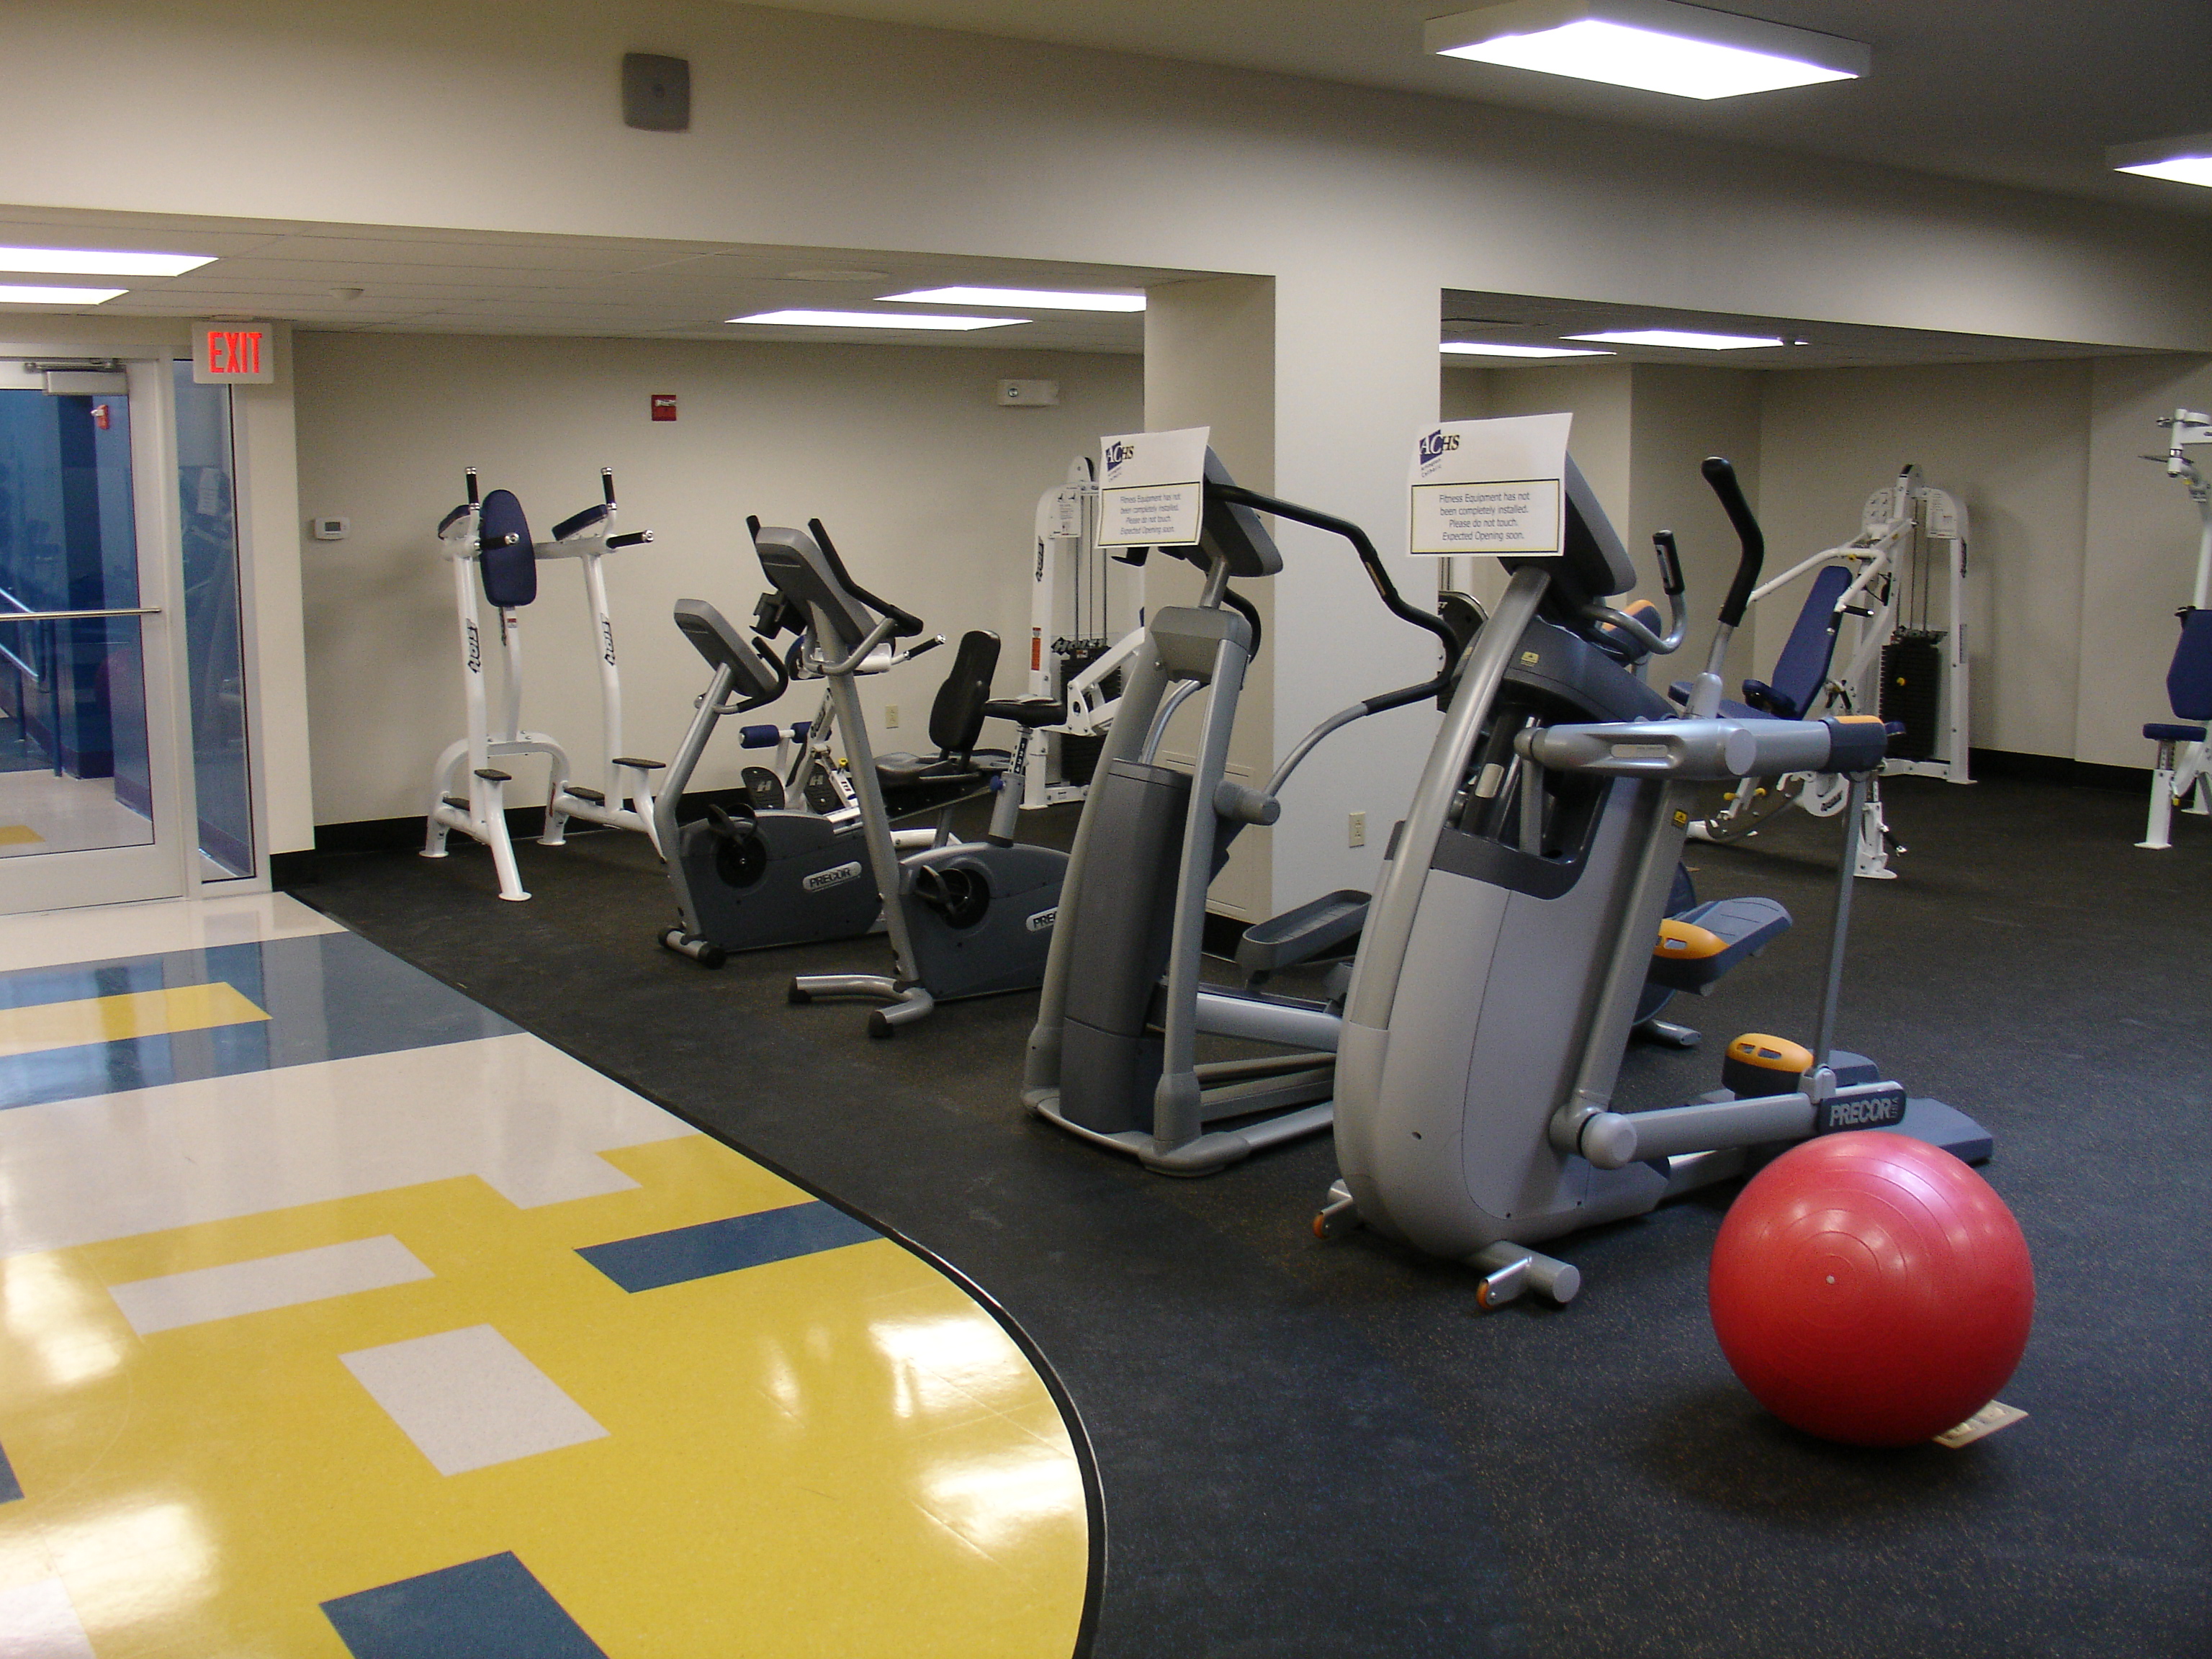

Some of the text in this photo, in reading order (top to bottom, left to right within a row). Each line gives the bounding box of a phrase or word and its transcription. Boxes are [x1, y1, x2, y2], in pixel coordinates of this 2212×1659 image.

[207, 331, 262, 373] EXIT
[1419, 434, 1460, 454] ACHS
[1107, 446, 1134, 462] ACHS
[1439, 494, 1463, 503] Fitness
[1465, 493, 1501, 503] Equipment
[1459, 506, 1495, 516] completely
[1498, 505, 1528, 513] installed.
[1449, 519, 1470, 528] Please
[1483, 518, 1496, 527] not
[1442, 531, 1473, 541] Expected
[1475, 531, 1503, 541] Opening
[809, 868, 850, 887] PRECOR
[1830, 1099, 1891, 1127] PRECOR
